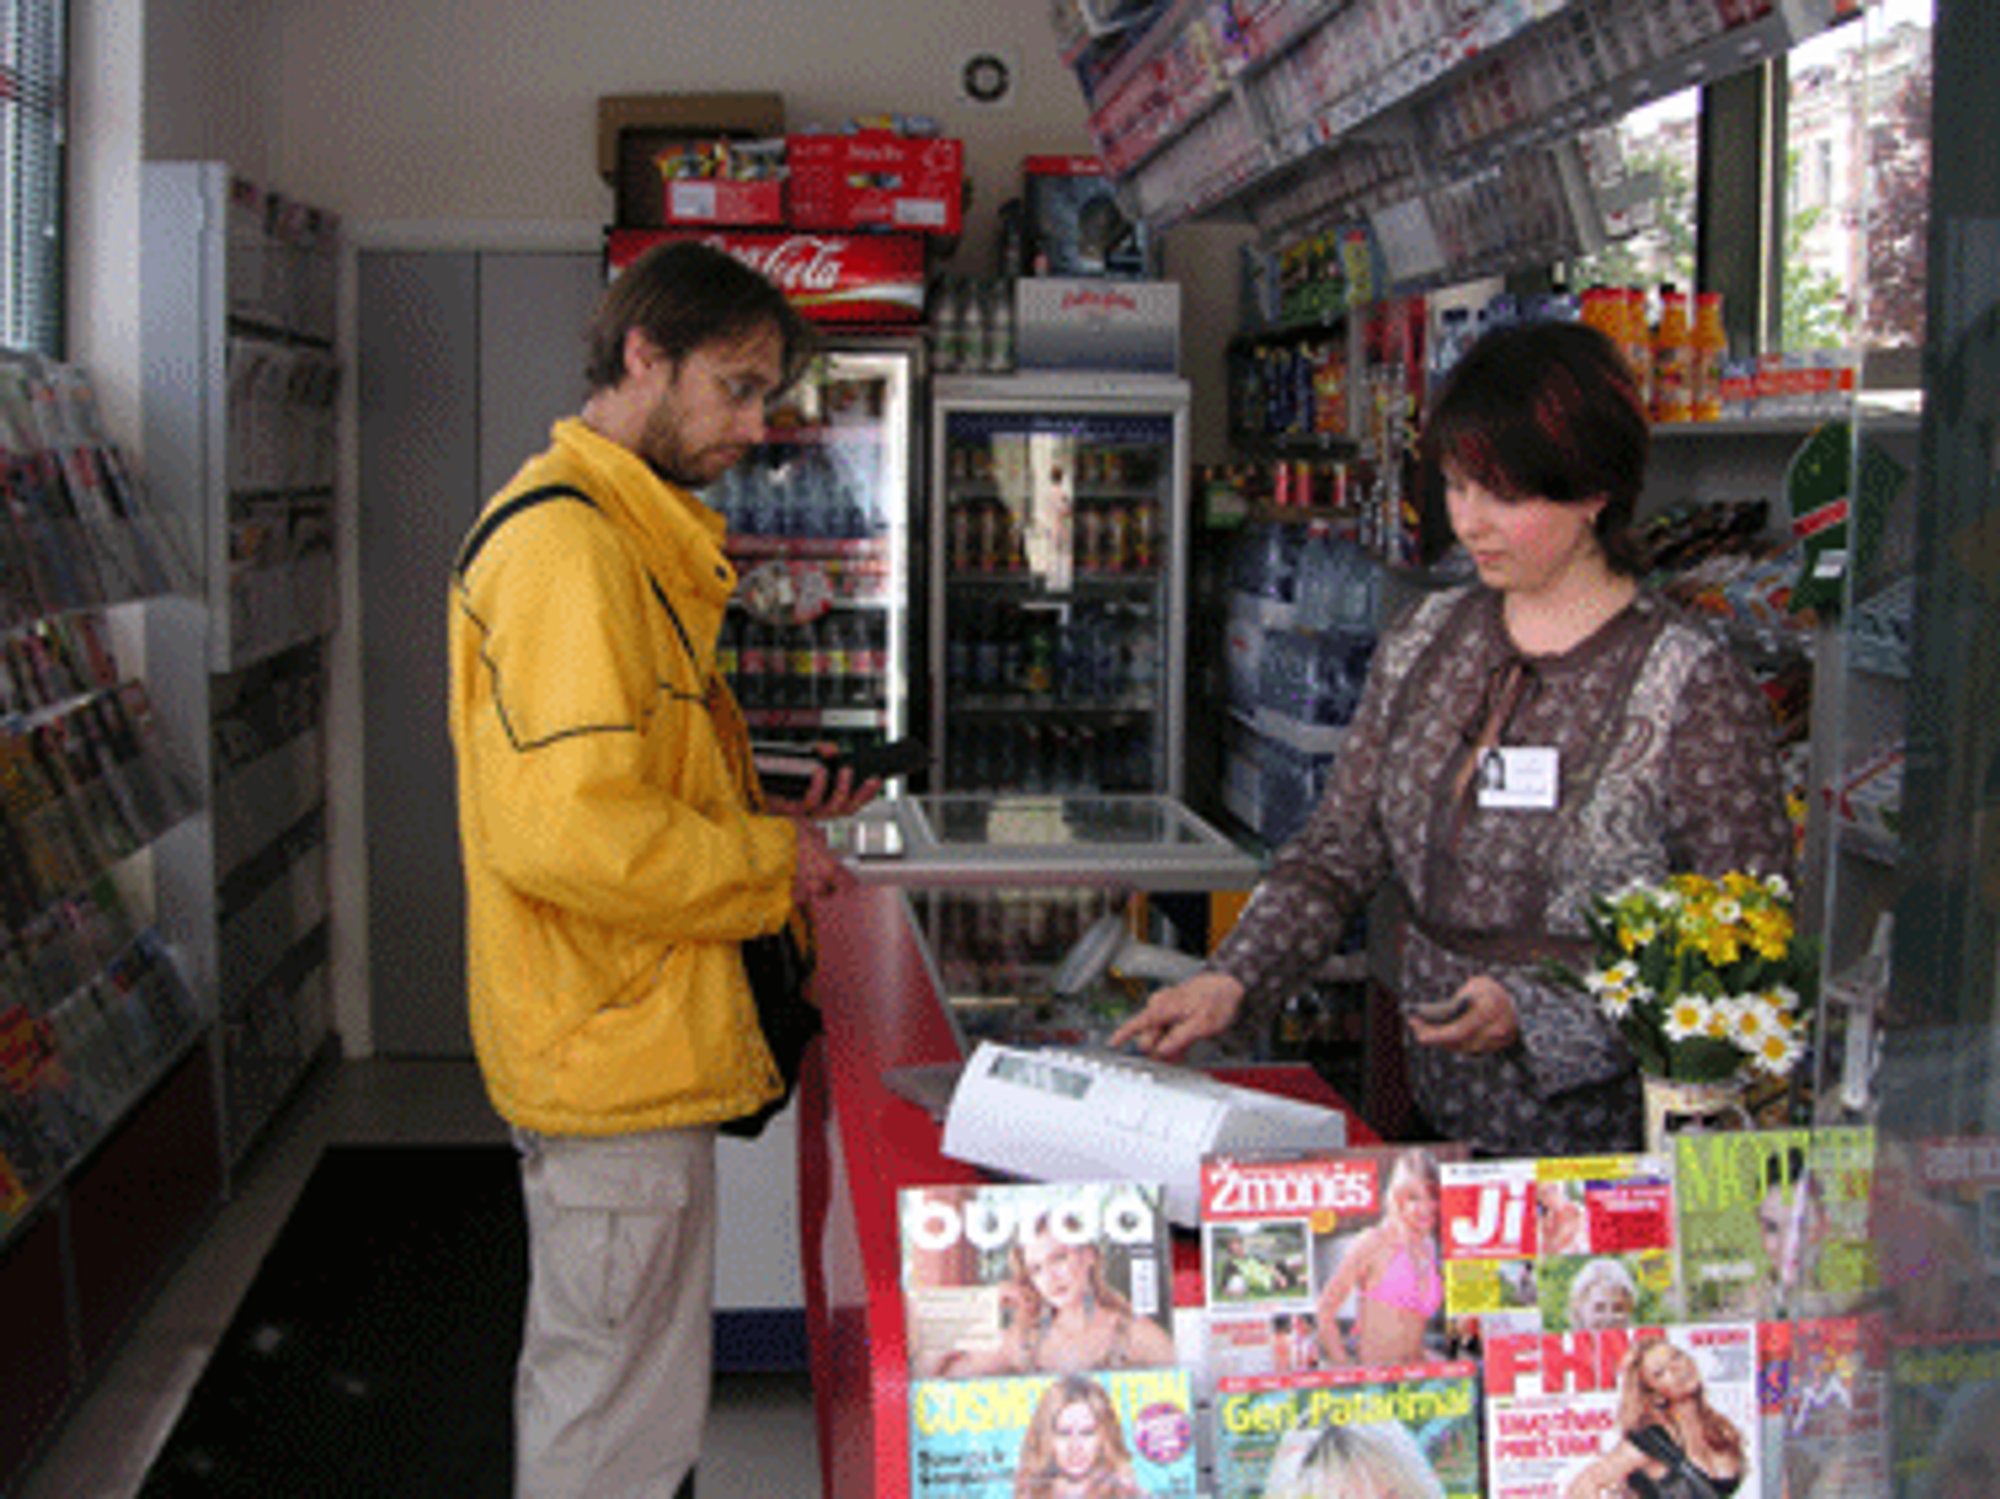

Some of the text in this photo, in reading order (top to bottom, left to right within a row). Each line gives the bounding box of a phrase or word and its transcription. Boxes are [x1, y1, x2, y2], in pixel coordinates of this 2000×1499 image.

[703, 234, 850, 290] a-Cola
[1210, 1157, 1373, 1213] Žmonės
[1452, 1180, 1526, 1244] Ji
[904, 1186, 1153, 1250] burda
[917, 1371, 1190, 1436] COSMOITAN
